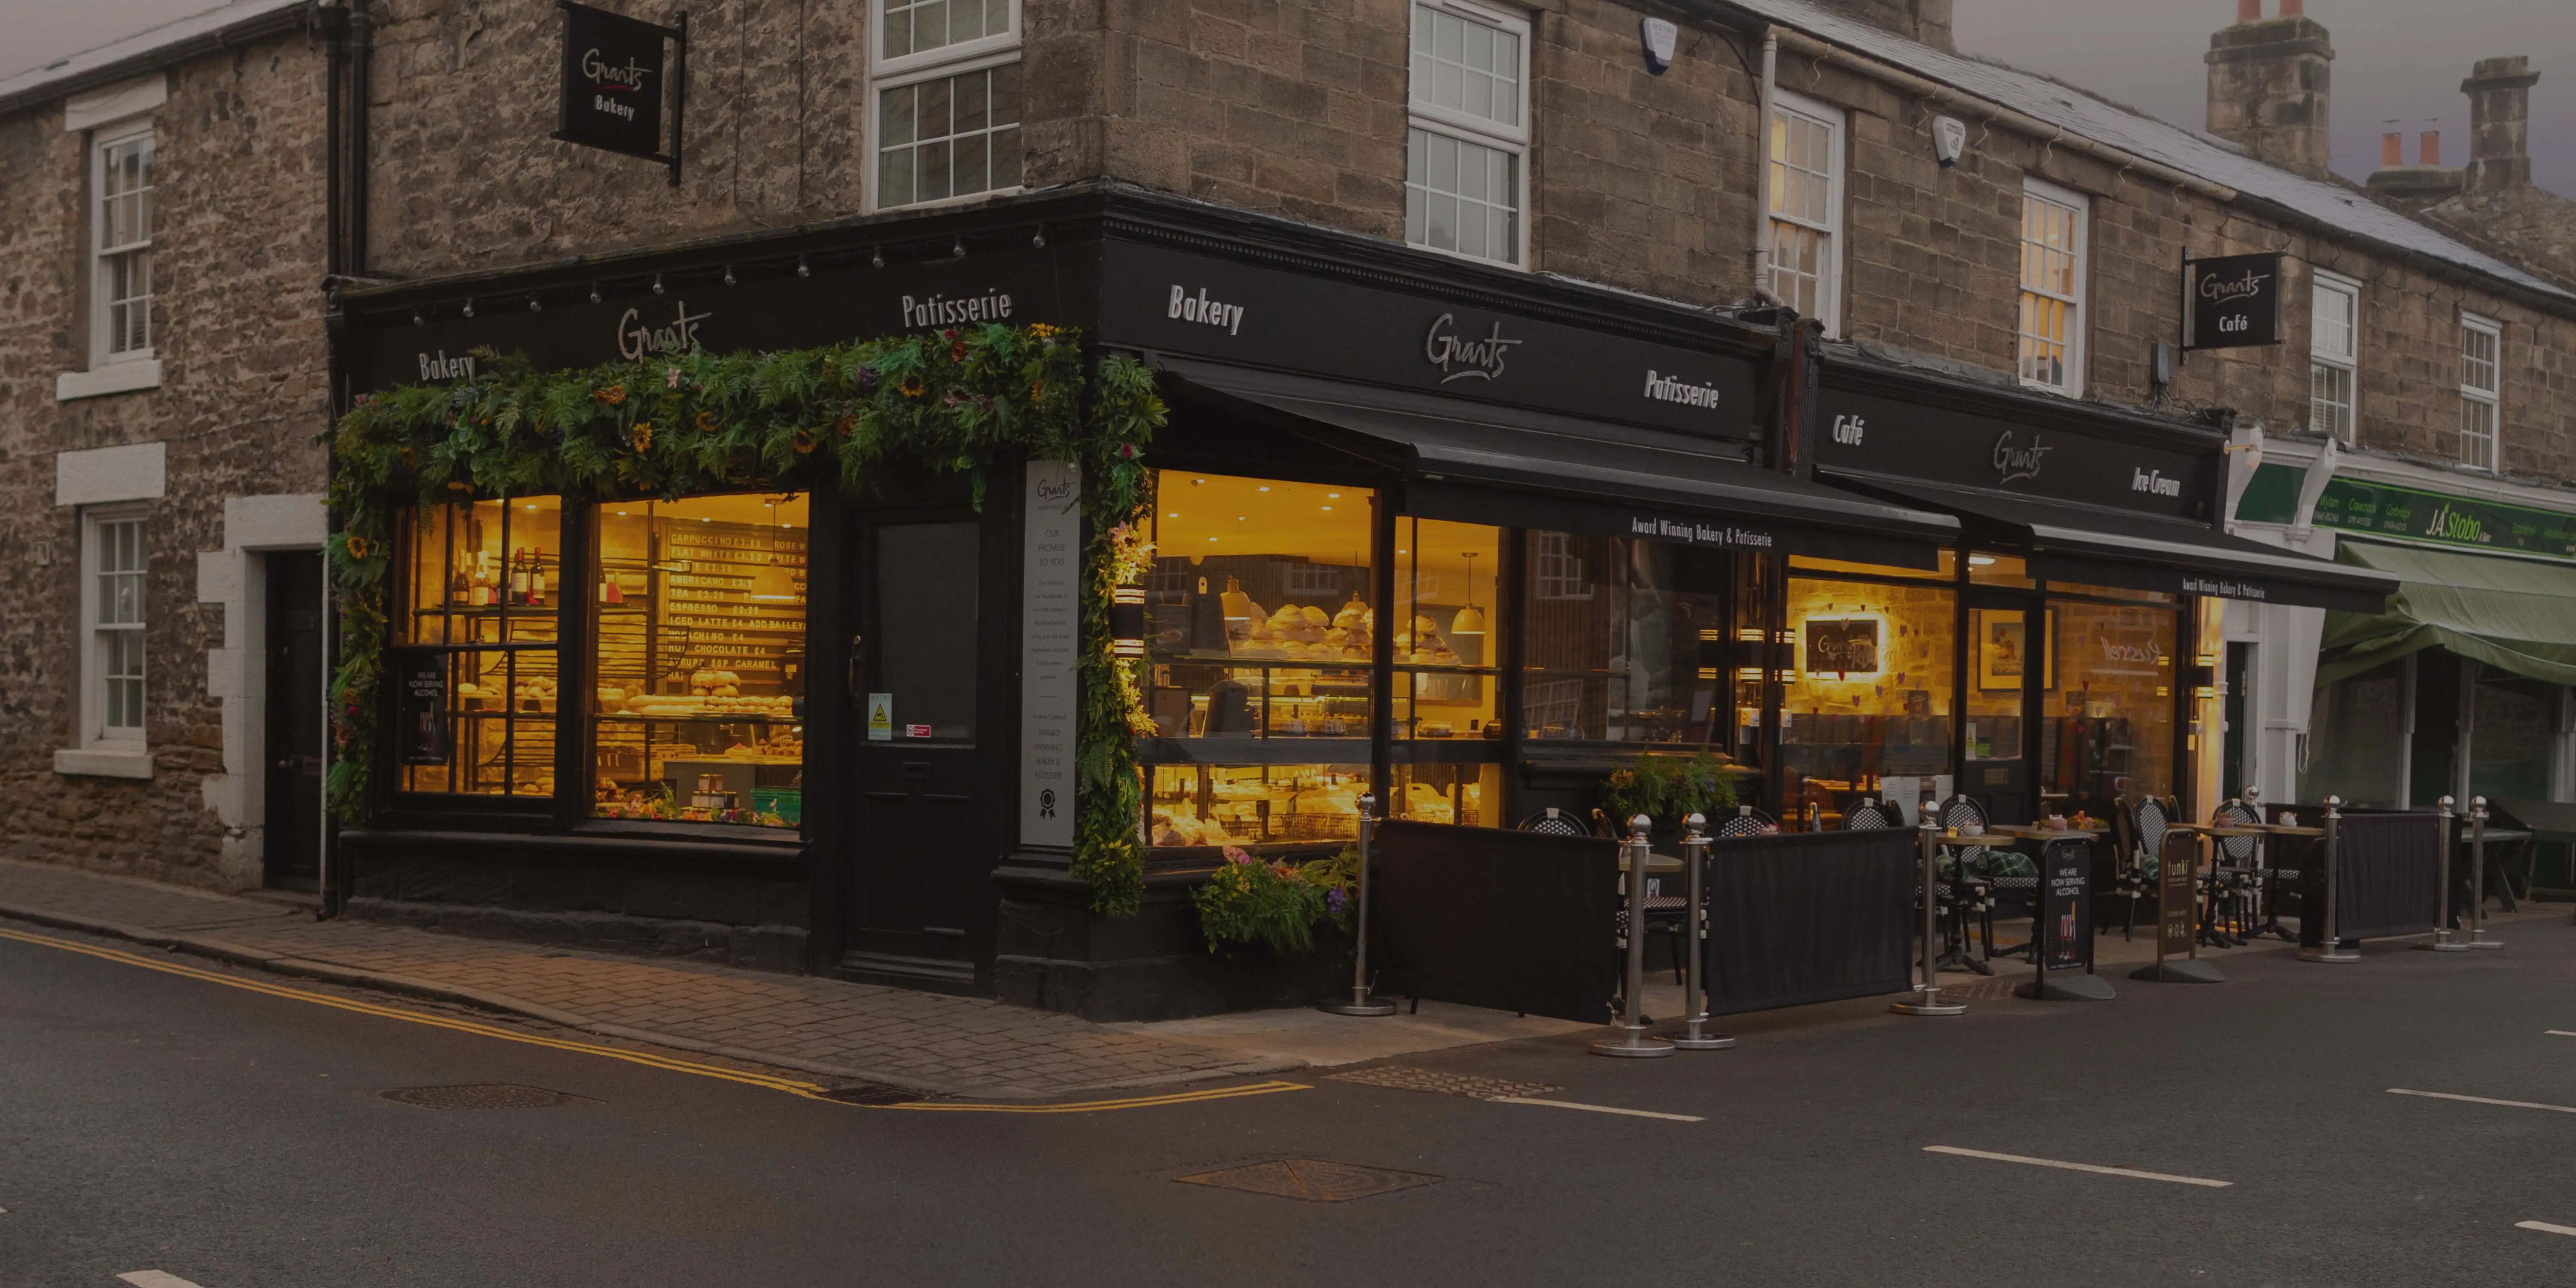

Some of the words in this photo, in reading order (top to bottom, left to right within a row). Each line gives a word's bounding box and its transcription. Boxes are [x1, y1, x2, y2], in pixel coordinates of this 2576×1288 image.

[582, 48, 653, 91] Grants
[594, 94, 635, 121] Bakery
[2200, 269, 2270, 300] Grants
[902, 287, 1012, 328] Patisserie
[1168, 285, 1244, 335] Bakery
[2219, 313, 2248, 332] Café
[618, 301, 713, 364] Grants
[1427, 313, 1523, 378] Grants
[418, 349, 475, 384] Bakery
[1644, 370, 1719, 409] Patisserie
[1833, 414, 1865, 446] Café
[1993, 430, 2052, 477] Grants
[1038, 477, 1076, 499] Grants
[2132, 467, 2149, 492] Ice
[2149, 469, 2180, 497] Cream
[2320, 494, 2339, 510] Wylam
[1632, 516, 1657, 535] Award
[1660, 519, 1693, 542] Winning
[1696, 522, 1723, 546] Bakery
[1726, 527, 1732, 543] &
[1735, 529, 1772, 547] Patisserie
[2445, 511, 2481, 541] Stobo
[671, 534, 731, 545] CAPPUCCINO
[775, 541, 796, 550] ROSE
[671, 547, 694, 557] FLAT
[700, 550, 731, 559] WHITE
[1039, 544, 1066, 552] PROMISE
[671, 575, 724, 585] AMERICANO
[671, 588, 688, 598] TEA
[2183, 577, 2197, 591] Award
[2198, 579, 2218, 596] Winning
[2220, 581, 2236, 598] Bakery
[2238, 583, 2241, 596] &
[2243, 584, 2265, 599] Patisserie
[670, 602, 718, 613] ESPRESSO
[732, 605, 759, 615] £2.20
[670, 616, 693, 626] ICED
[699, 617, 727, 627] LATTE
[732, 619, 743, 628] £4
[749, 620, 767, 629] ADD
[732, 634, 744, 642] £4
[695, 644, 748, 655] CHOCOLATE
[754, 647, 765, 655] £4
[735, 659, 777, 669] CARAMEL
[424, 680, 444, 689] SERVING
[1037, 728, 1060, 737] AWARD
[1034, 743, 1064, 751] WINNING
[1036, 757, 1054, 766] BAKER
[2059, 869, 2067, 877] WE
[2067, 868, 2078, 876] ARE
[2051, 878, 2064, 887] NOW
[2065, 877, 2085, 887] SERVING
[2056, 887, 2080, 896] ALCOHOL
